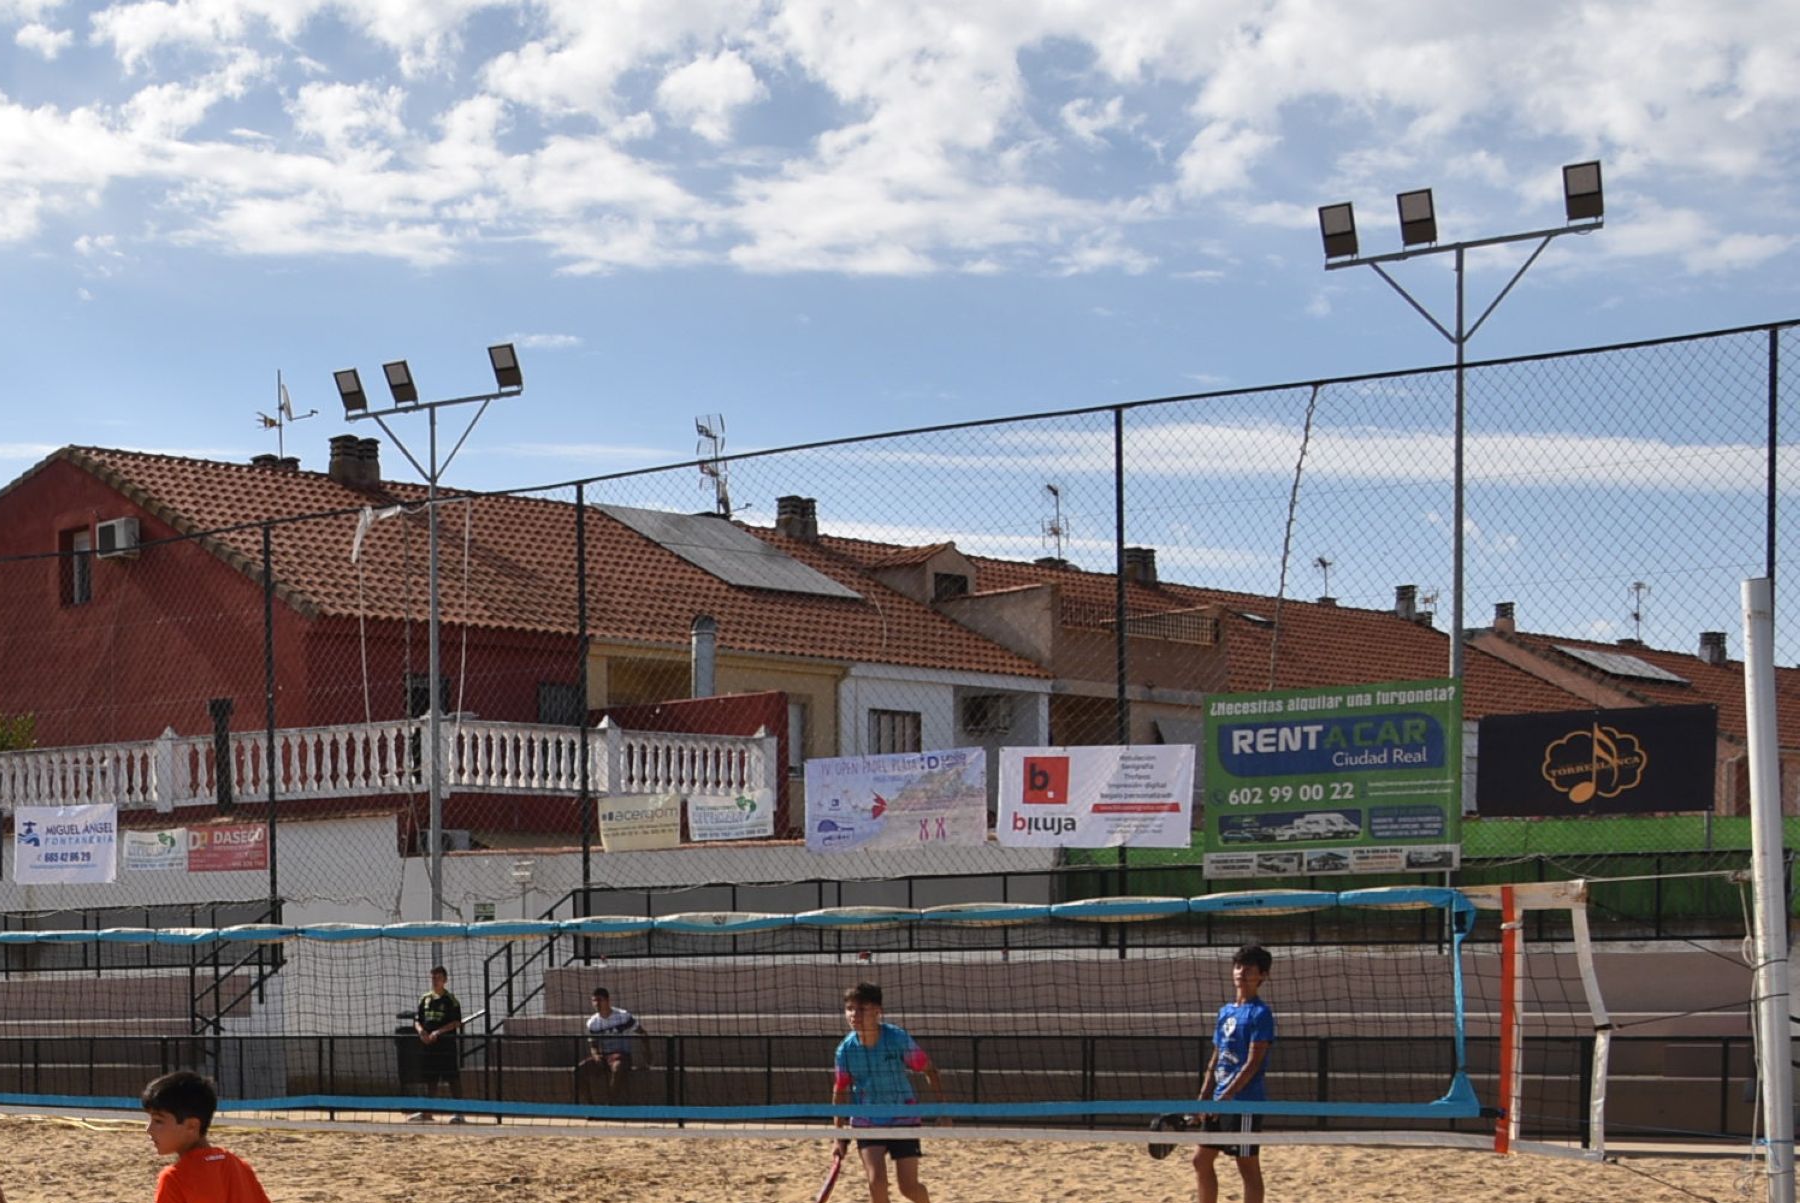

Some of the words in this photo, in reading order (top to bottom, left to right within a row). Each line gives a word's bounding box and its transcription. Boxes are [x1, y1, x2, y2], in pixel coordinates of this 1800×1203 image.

[1210, 699, 1283, 717] ¿Necesitas
[1287, 695, 1343, 712] alquilar
[1346, 692, 1372, 707] una
[1376, 686, 1455, 706] furgoneta?
[1232, 724, 1324, 755] RENT
[1352, 718, 1427, 747] CAR
[1332, 750, 1388, 767] Ciudad
[1392, 746, 1427, 764] Real
[1548, 755, 1641, 777] TORRELNCA
[1228, 786, 1263, 805] 602
[1268, 785, 1293, 803] 99
[1299, 783, 1324, 801] 00
[1329, 782, 1355, 800] 22
[614, 806, 678, 823] acergom
[46, 823, 80, 836] MIGUEL
